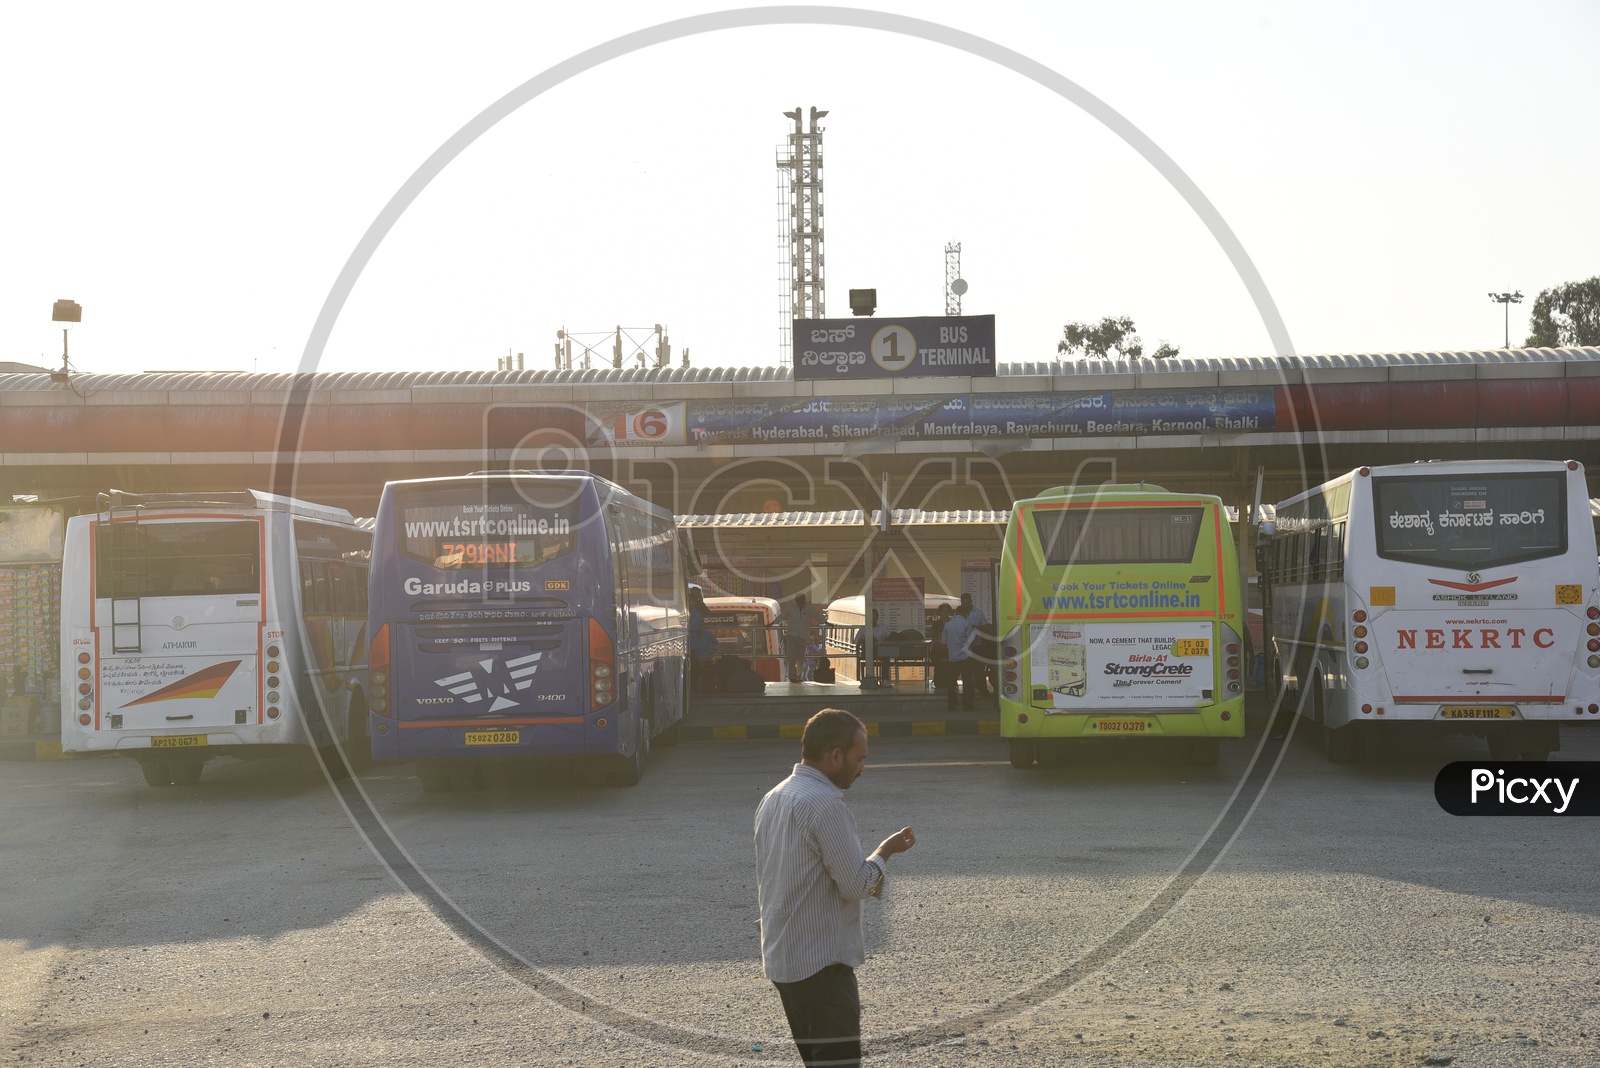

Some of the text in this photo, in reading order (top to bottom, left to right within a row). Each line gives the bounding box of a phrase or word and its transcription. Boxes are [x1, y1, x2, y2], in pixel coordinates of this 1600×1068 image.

[810, 324, 856, 343] ಬಸ್
[939, 326, 968, 344] BUS
[882, 331, 906, 362] 1
[801, 350, 867, 373] ನಿಲ್ದಾಣ
[919, 347, 990, 366] TERMINAL
[602, 411, 668, 439] 16
[691, 427, 749, 442] Towards
[752, 425, 828, 441] Hyderabad,
[924, 421, 1002, 437] Mantralaya,
[1087, 420, 1148, 435] Beedara,
[463, 504, 514, 514] Book Your Tickets Online
[404, 513, 570, 538] www.tsrtconline.in
[1389, 508, 1545, 536] ಈಶಾನ್ಯ ಕರ್ನಾಟಕ ಸಾರಿಗೆ
[403, 577, 531, 596] Garuda PLUS
[1052, 580, 1186, 591] Book Your Tickets Online
[1042, 590, 1200, 610] www.tsrtconline.in
[267, 631, 285, 639] STOP
[1089, 637, 1105, 645] NOW,
[1154, 636, 1176, 644] BUILDS
[1396, 628, 1556, 649] NEKRTC
[162, 641, 198, 650] ATMAKUR
[1191, 647, 1209, 655] 0378
[1103, 662, 1193, 677] StrongCrete
[415, 697, 454, 705] VOLVO
[537, 694, 566, 702] 9400
